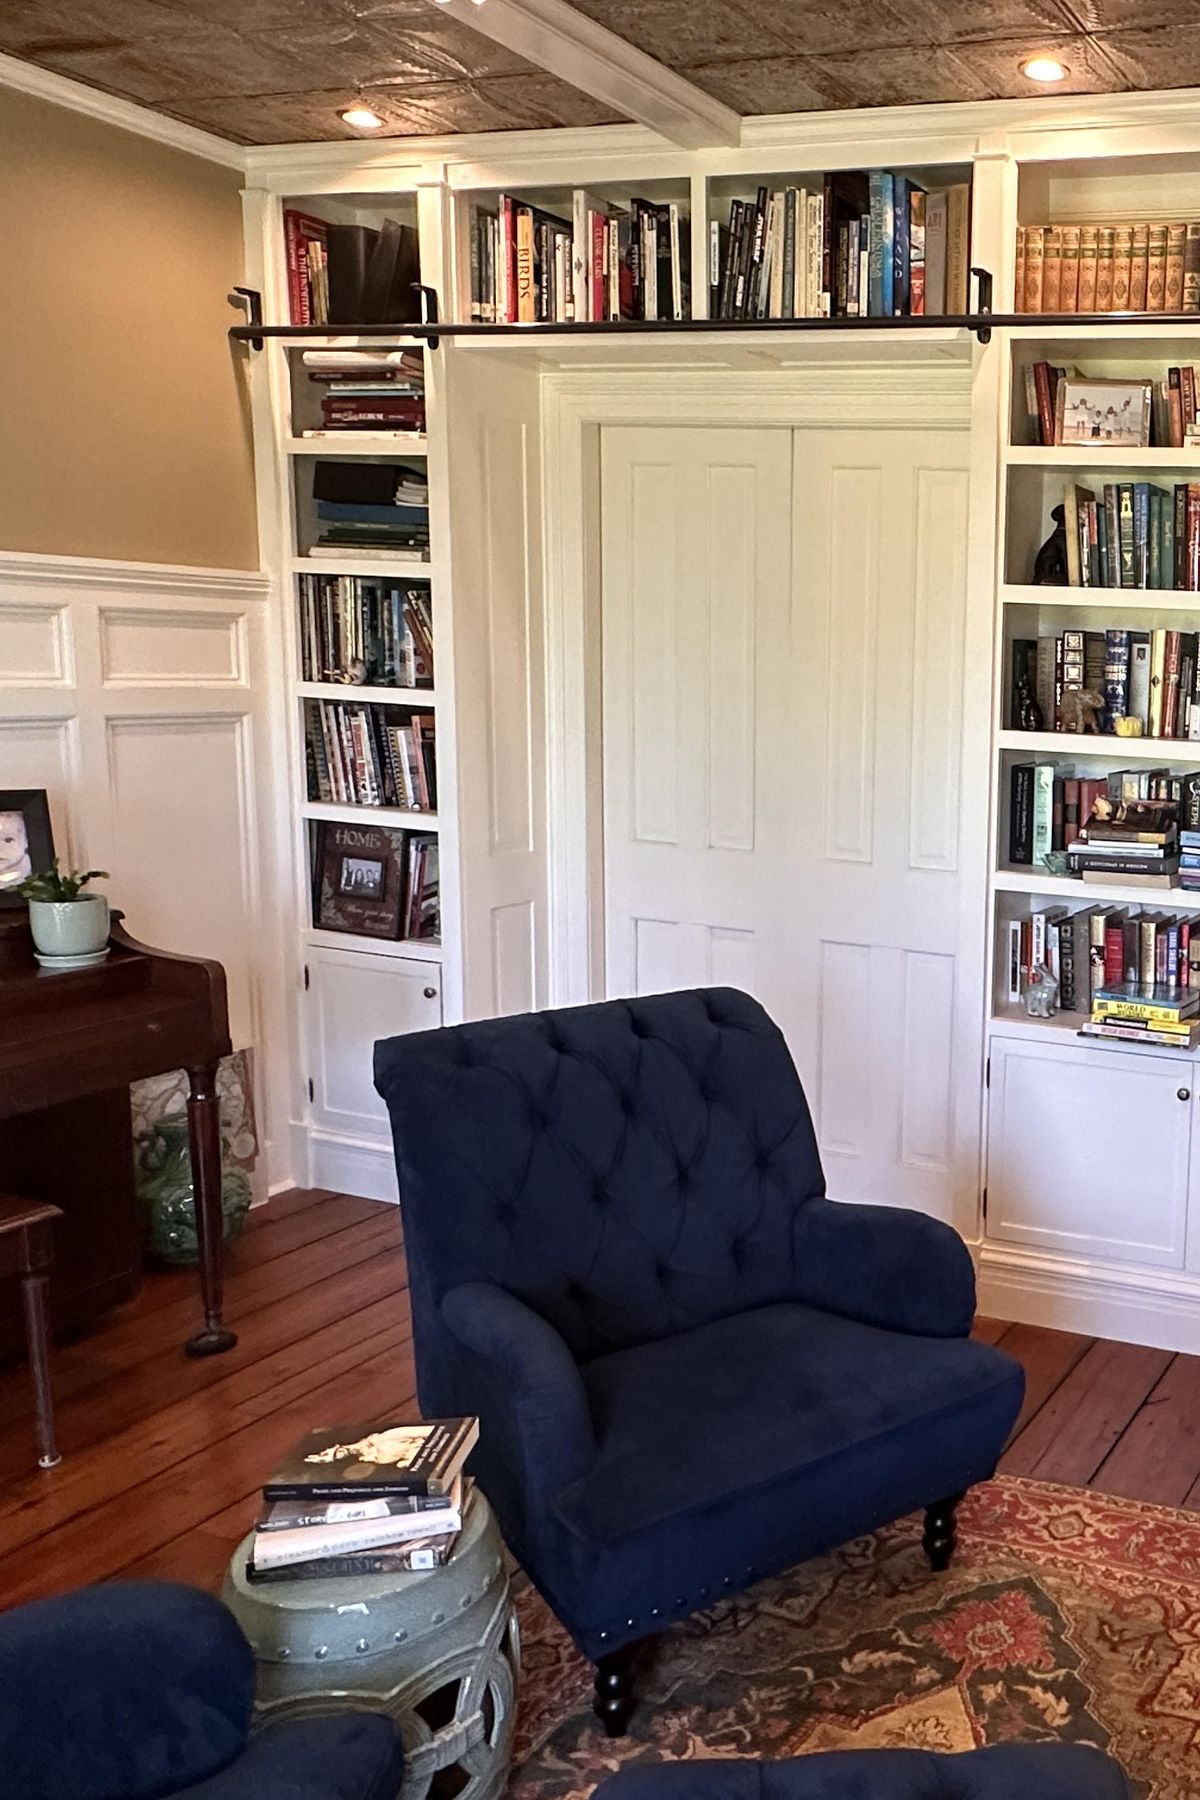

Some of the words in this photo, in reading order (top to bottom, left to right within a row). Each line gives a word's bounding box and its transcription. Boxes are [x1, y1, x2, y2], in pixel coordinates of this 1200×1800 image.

[756, 213, 764, 238] STAR
[753, 239, 761, 263] WARS
[518, 248, 530, 300] BIRDS
[335, 830, 382, 848] HOME
[1116, 1003, 1145, 1012] WORLD
